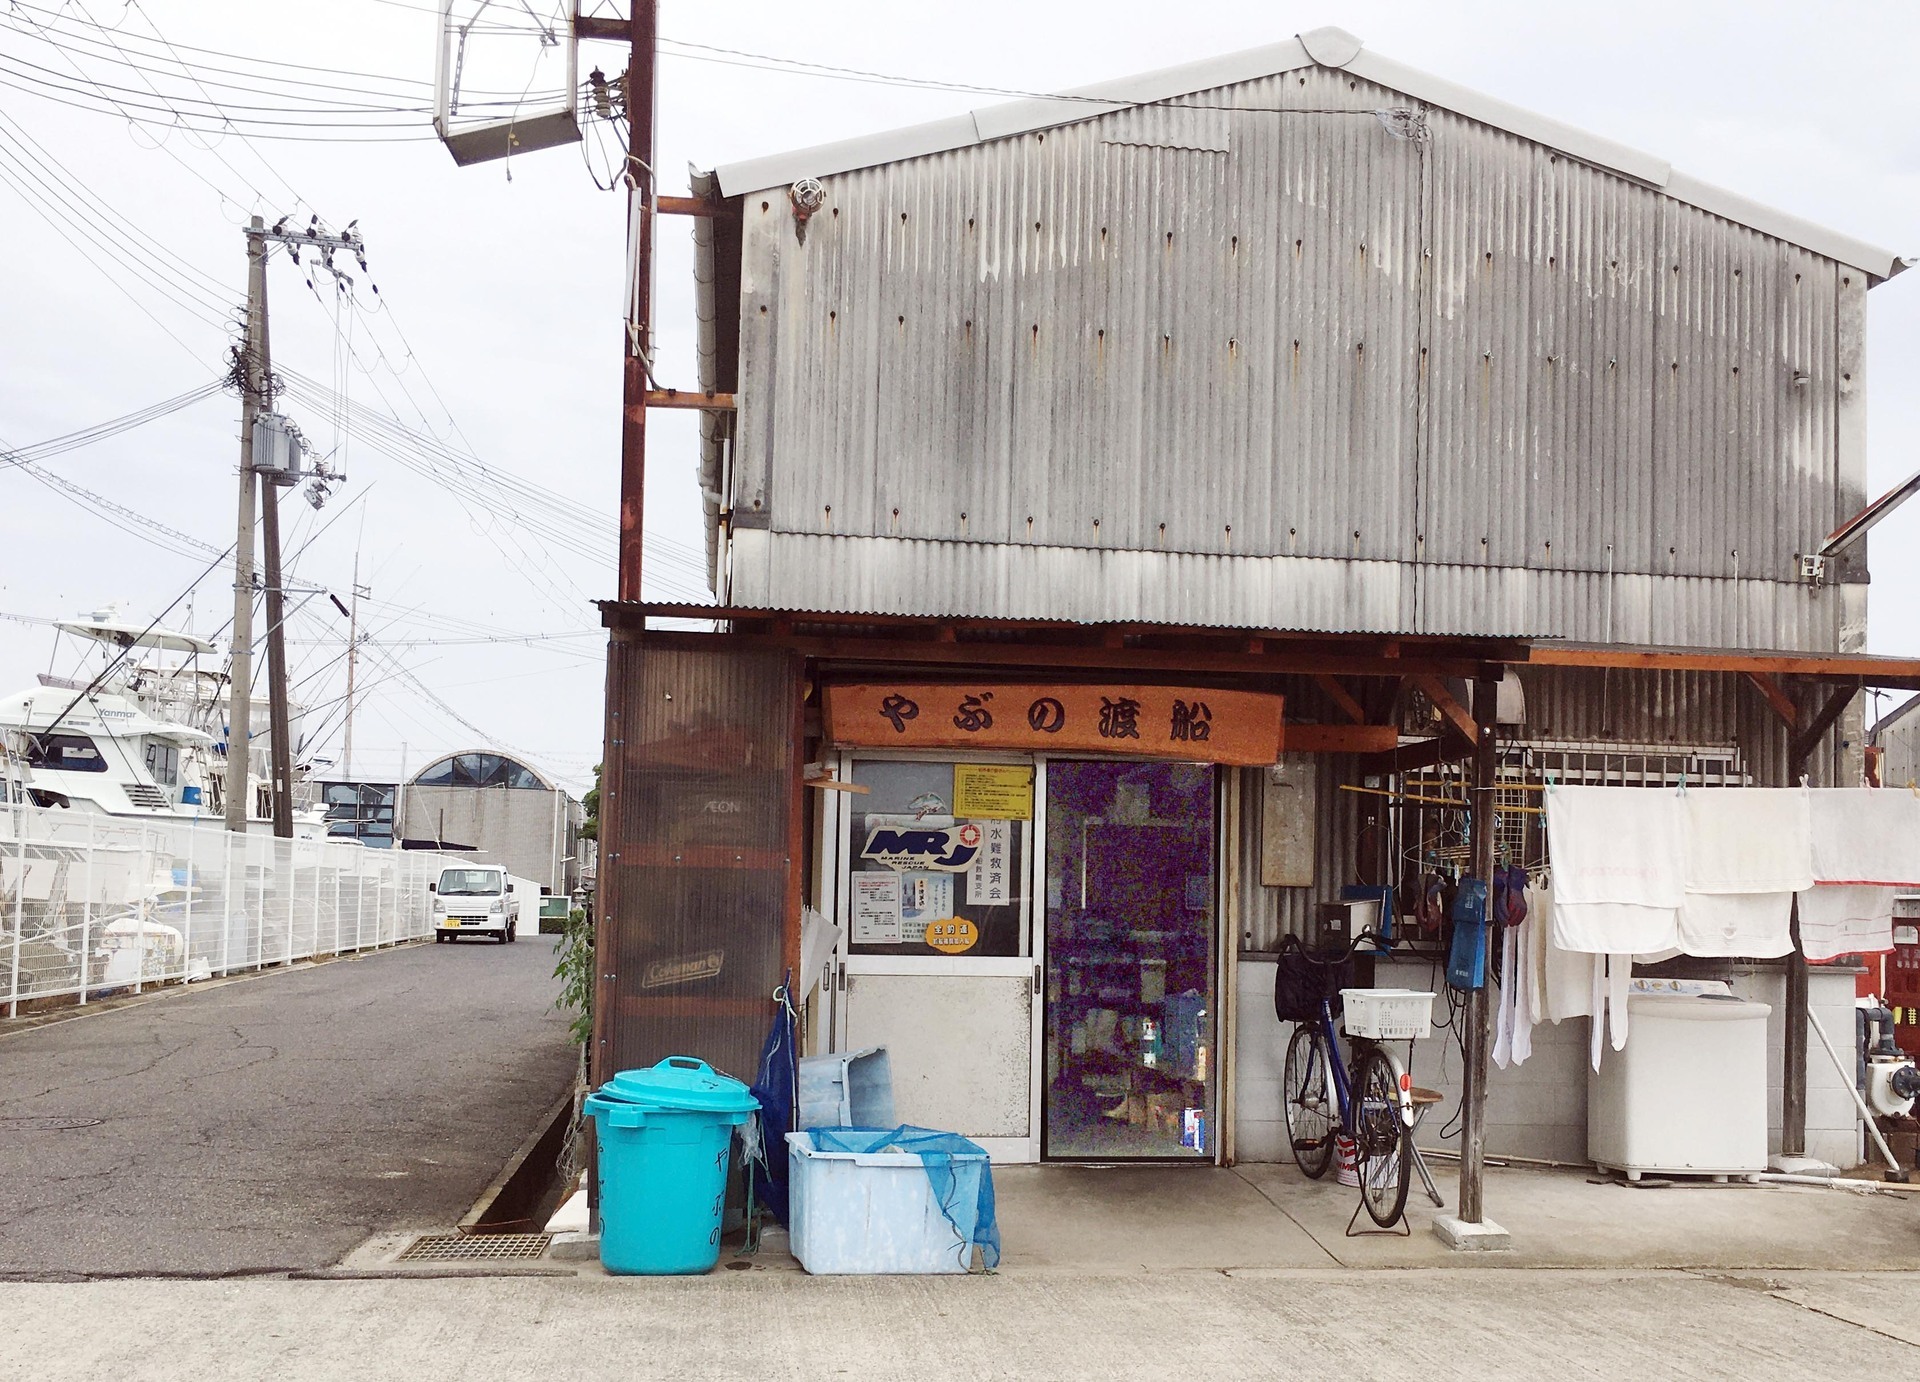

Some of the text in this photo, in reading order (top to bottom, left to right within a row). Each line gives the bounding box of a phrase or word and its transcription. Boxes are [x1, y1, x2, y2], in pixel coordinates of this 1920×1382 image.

[99, 708, 137, 719] Yanmar
[879, 692, 1213, 742] やぶの渡船
